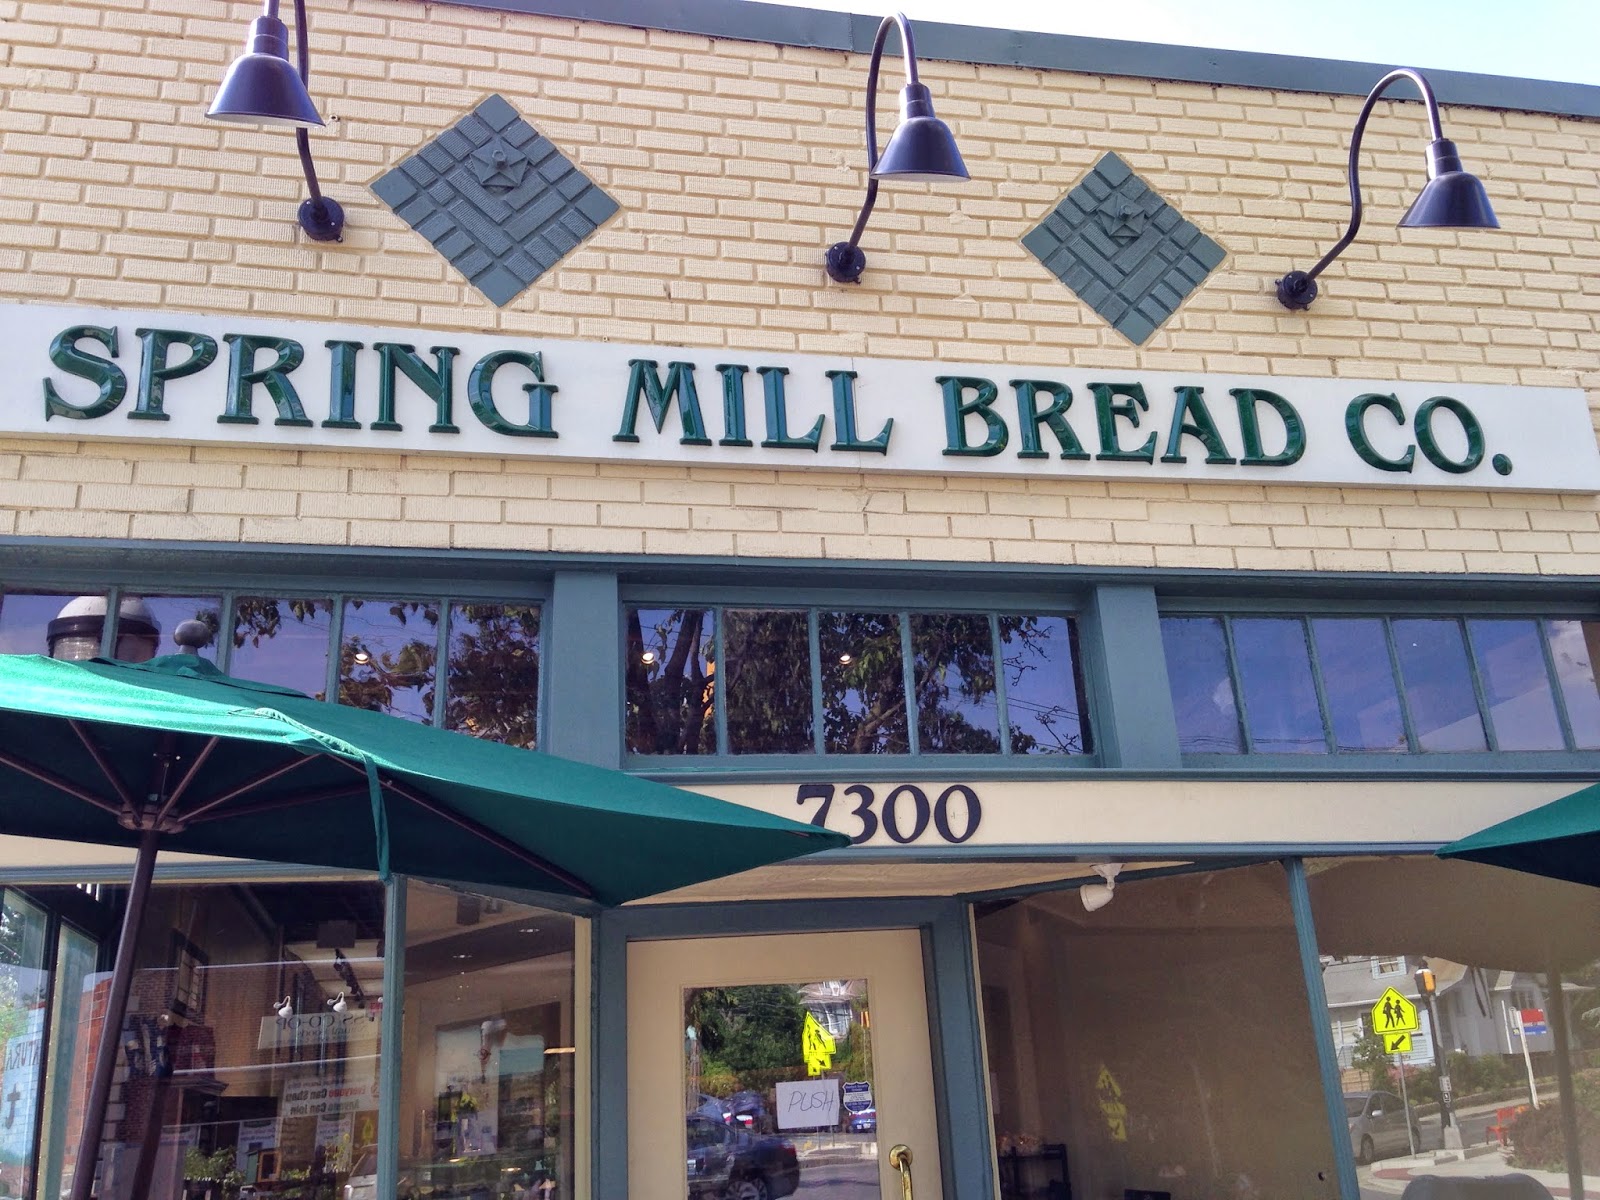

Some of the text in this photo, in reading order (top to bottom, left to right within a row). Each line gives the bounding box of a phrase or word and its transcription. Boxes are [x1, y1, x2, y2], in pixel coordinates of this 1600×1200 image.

[43, 325, 1513, 476] SPRING MILL BREAD CO.
[796, 784, 982, 844] 7300
[788, 1091, 834, 1112] PUSH
